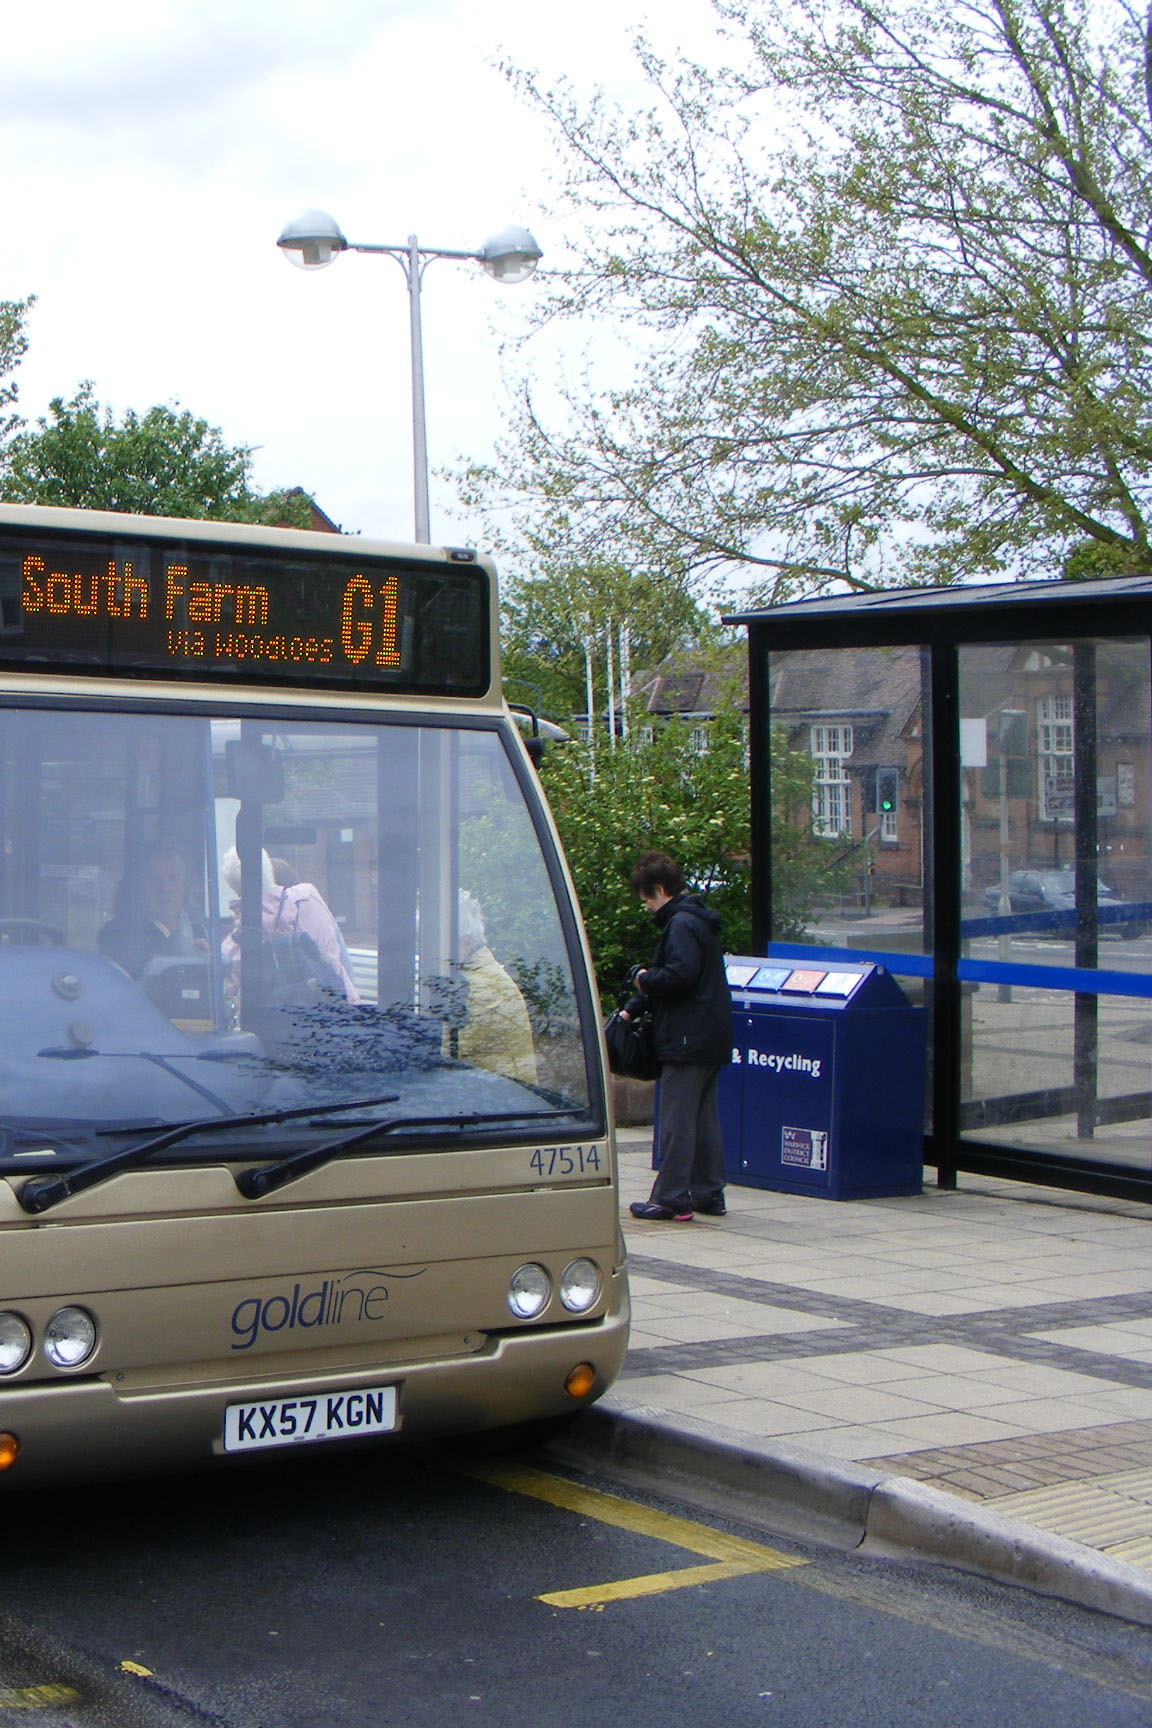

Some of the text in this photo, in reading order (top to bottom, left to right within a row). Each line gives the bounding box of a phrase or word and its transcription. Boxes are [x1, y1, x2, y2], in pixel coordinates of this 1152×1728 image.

[22, 554, 403, 667] South Farm G1
[731, 1047, 822, 1078] & Recycling
[529, 1144, 602, 1177] 47514
[230, 1279, 389, 1350] goldline
[238, 1392, 384, 1442] KX57 KGN
